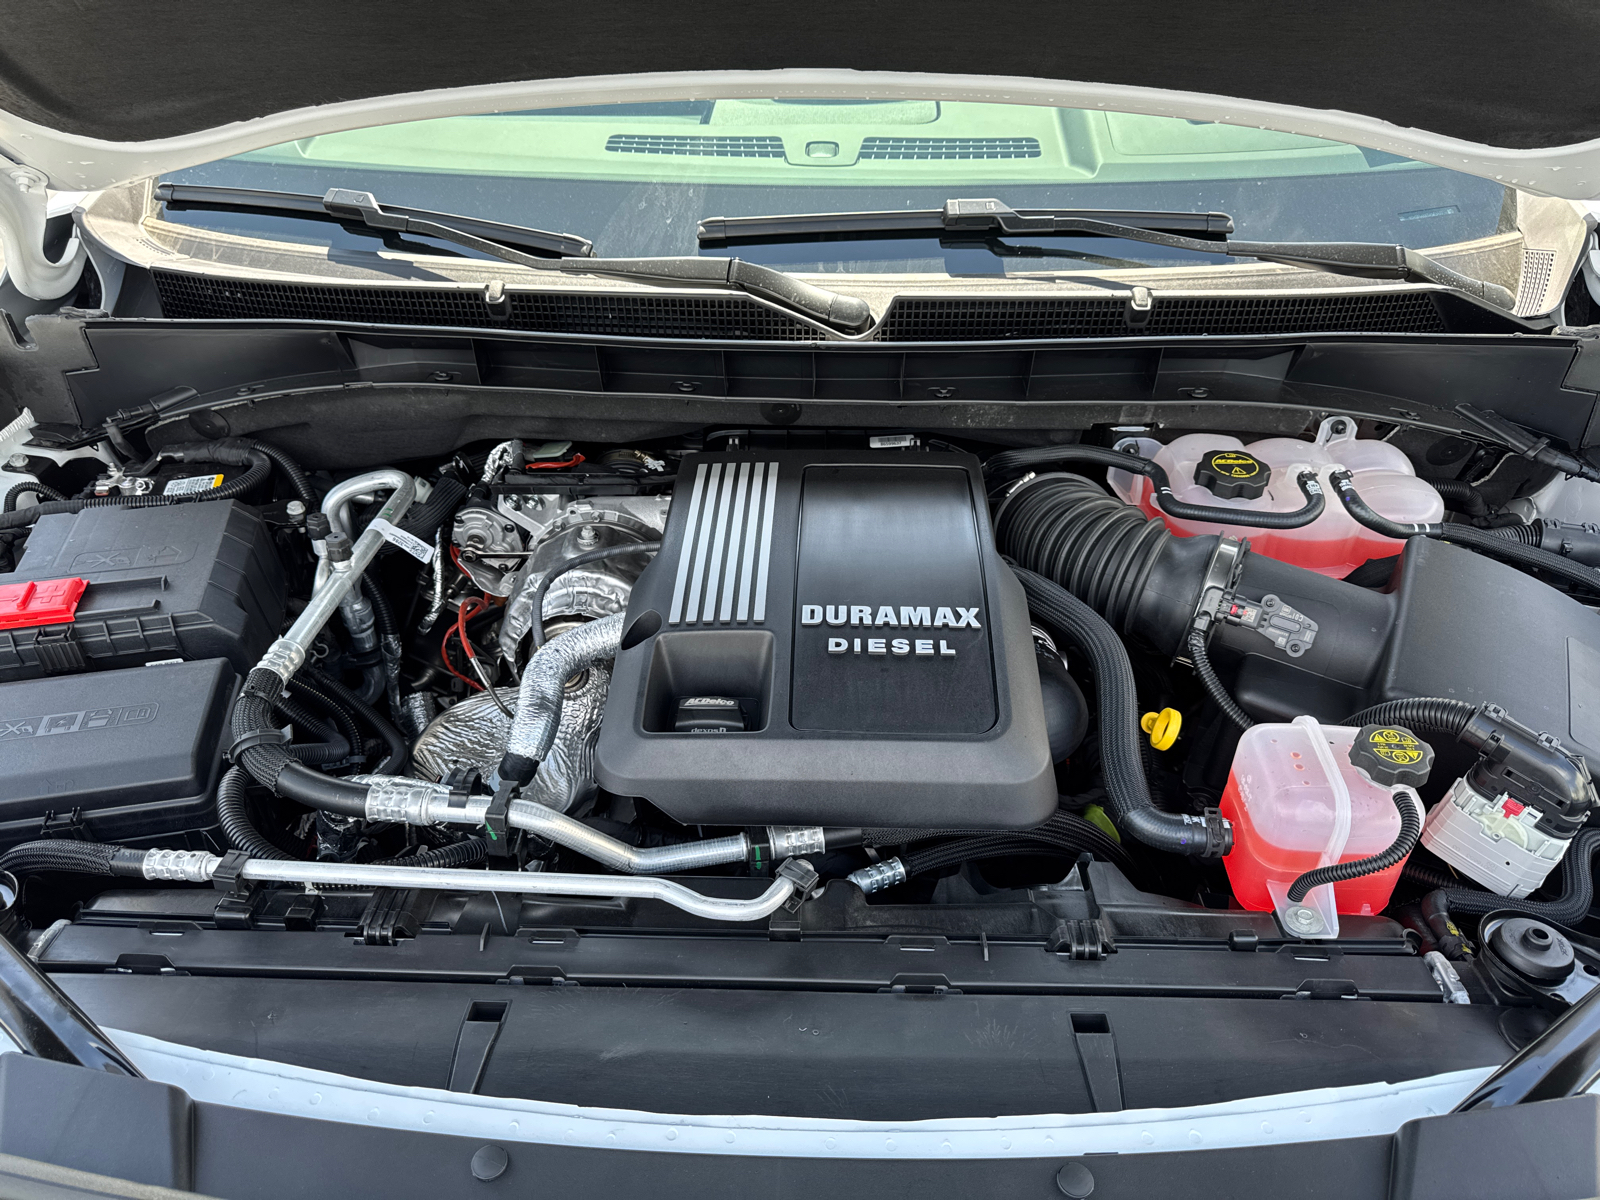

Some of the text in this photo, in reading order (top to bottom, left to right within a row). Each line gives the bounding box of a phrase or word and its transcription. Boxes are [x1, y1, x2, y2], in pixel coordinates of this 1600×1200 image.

[801, 604, 982, 629] DURAMAX
[828, 637, 957, 656] DIESEL
[683, 697, 735, 707] ACDelco
